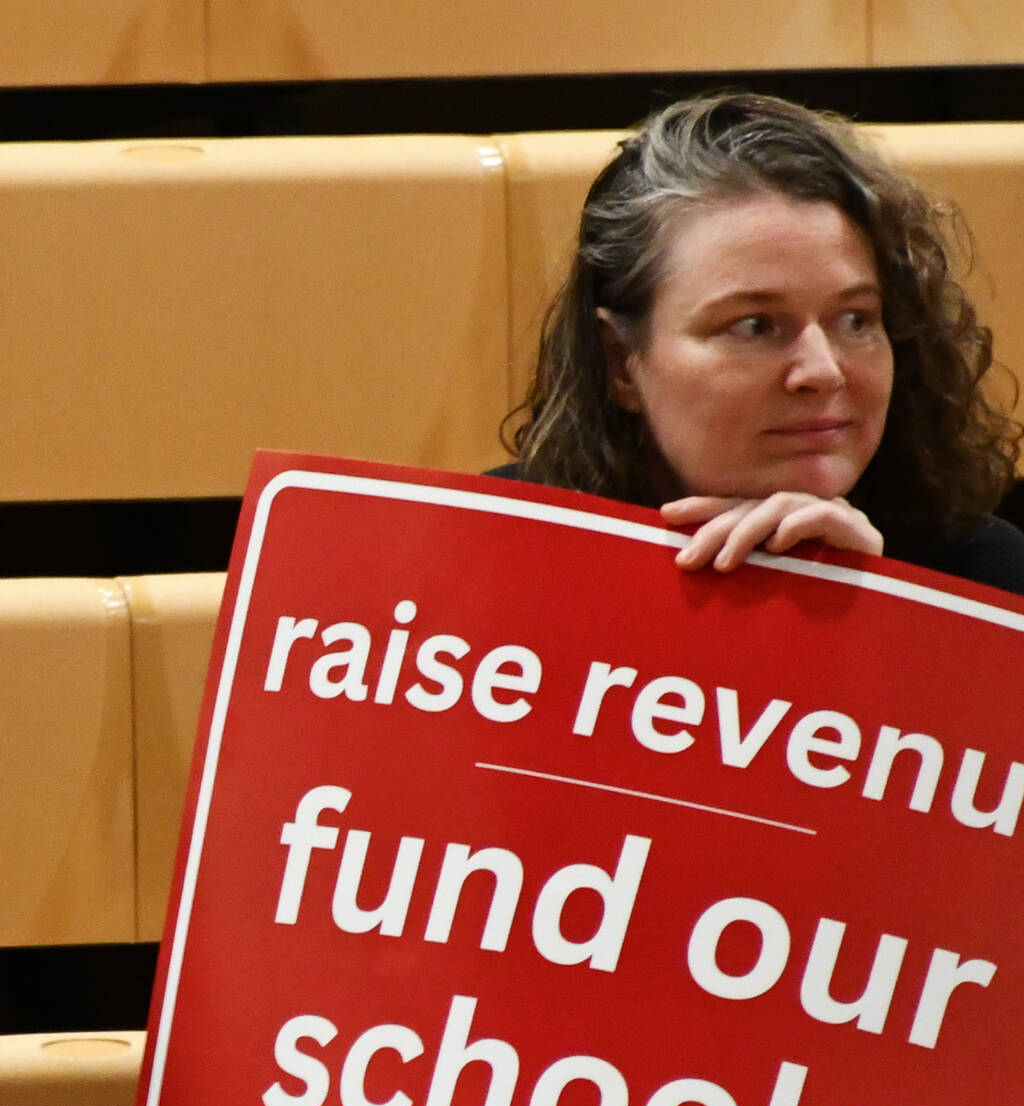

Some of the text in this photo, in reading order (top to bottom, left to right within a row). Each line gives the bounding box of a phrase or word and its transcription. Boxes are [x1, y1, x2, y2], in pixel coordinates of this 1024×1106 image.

[263, 599, 542, 723] raise
[274, 784, 998, 1049] fund our
